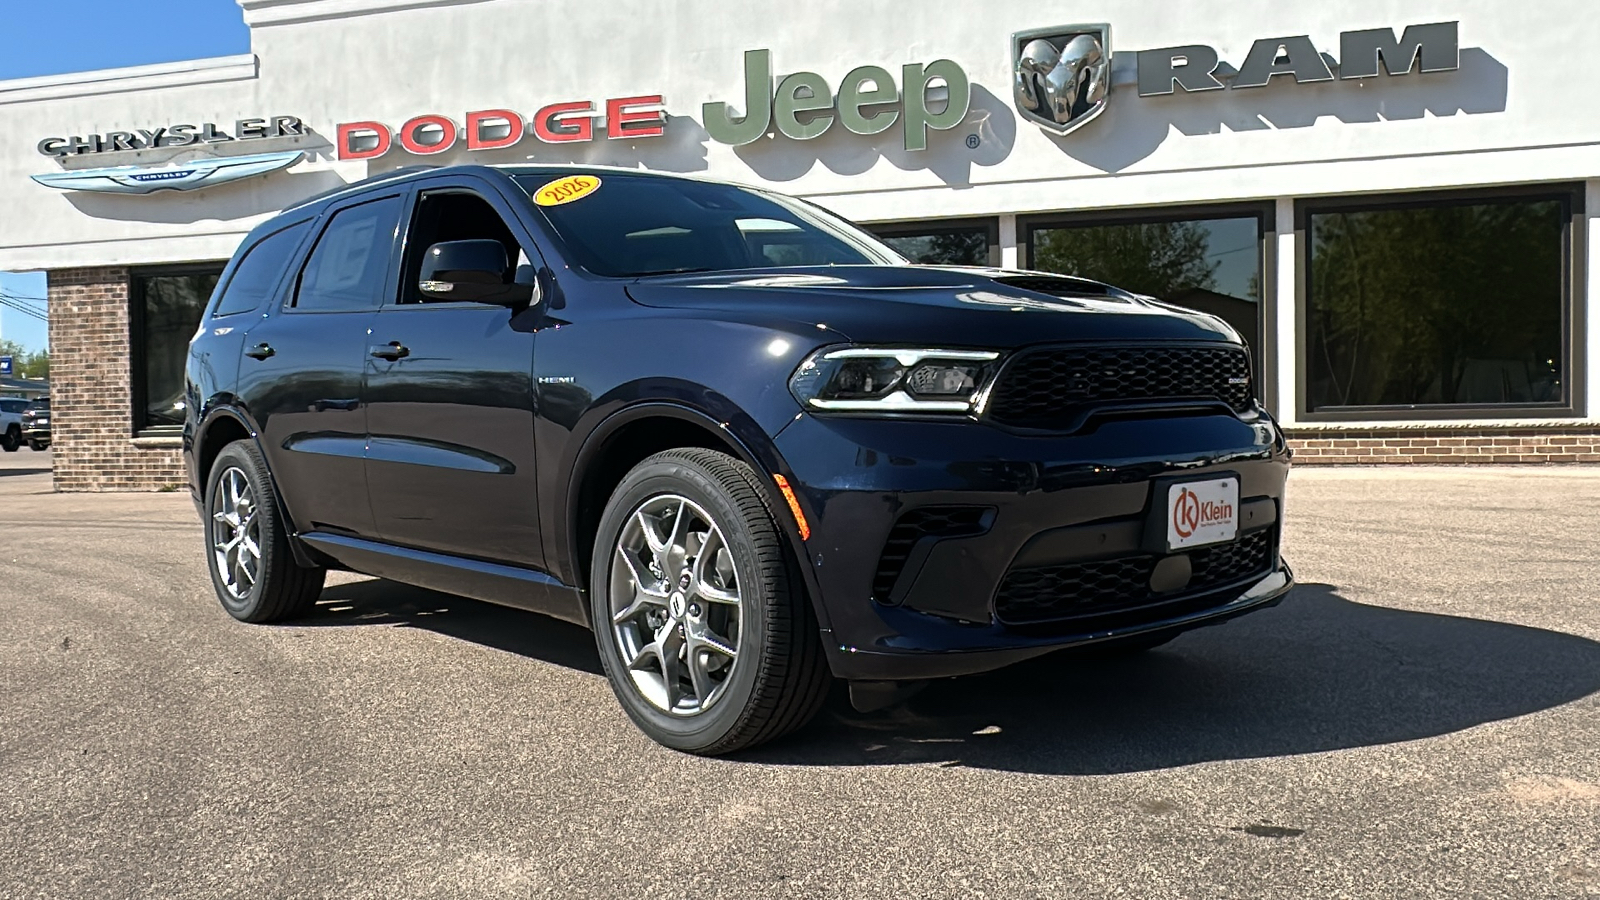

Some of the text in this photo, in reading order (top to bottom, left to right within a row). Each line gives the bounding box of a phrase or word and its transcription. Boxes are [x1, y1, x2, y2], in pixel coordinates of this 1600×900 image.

[1137, 21, 1459, 97] RAM
[702, 49, 971, 151] Jeep
[37, 115, 303, 156] CHRYSLER
[336, 95, 666, 161] DODGE
[136, 171, 189, 181] CHRYSLER
[545, 177, 591, 202] 2026
[538, 376, 575, 384] HEMI
[1201, 500, 1232, 522] Klein
